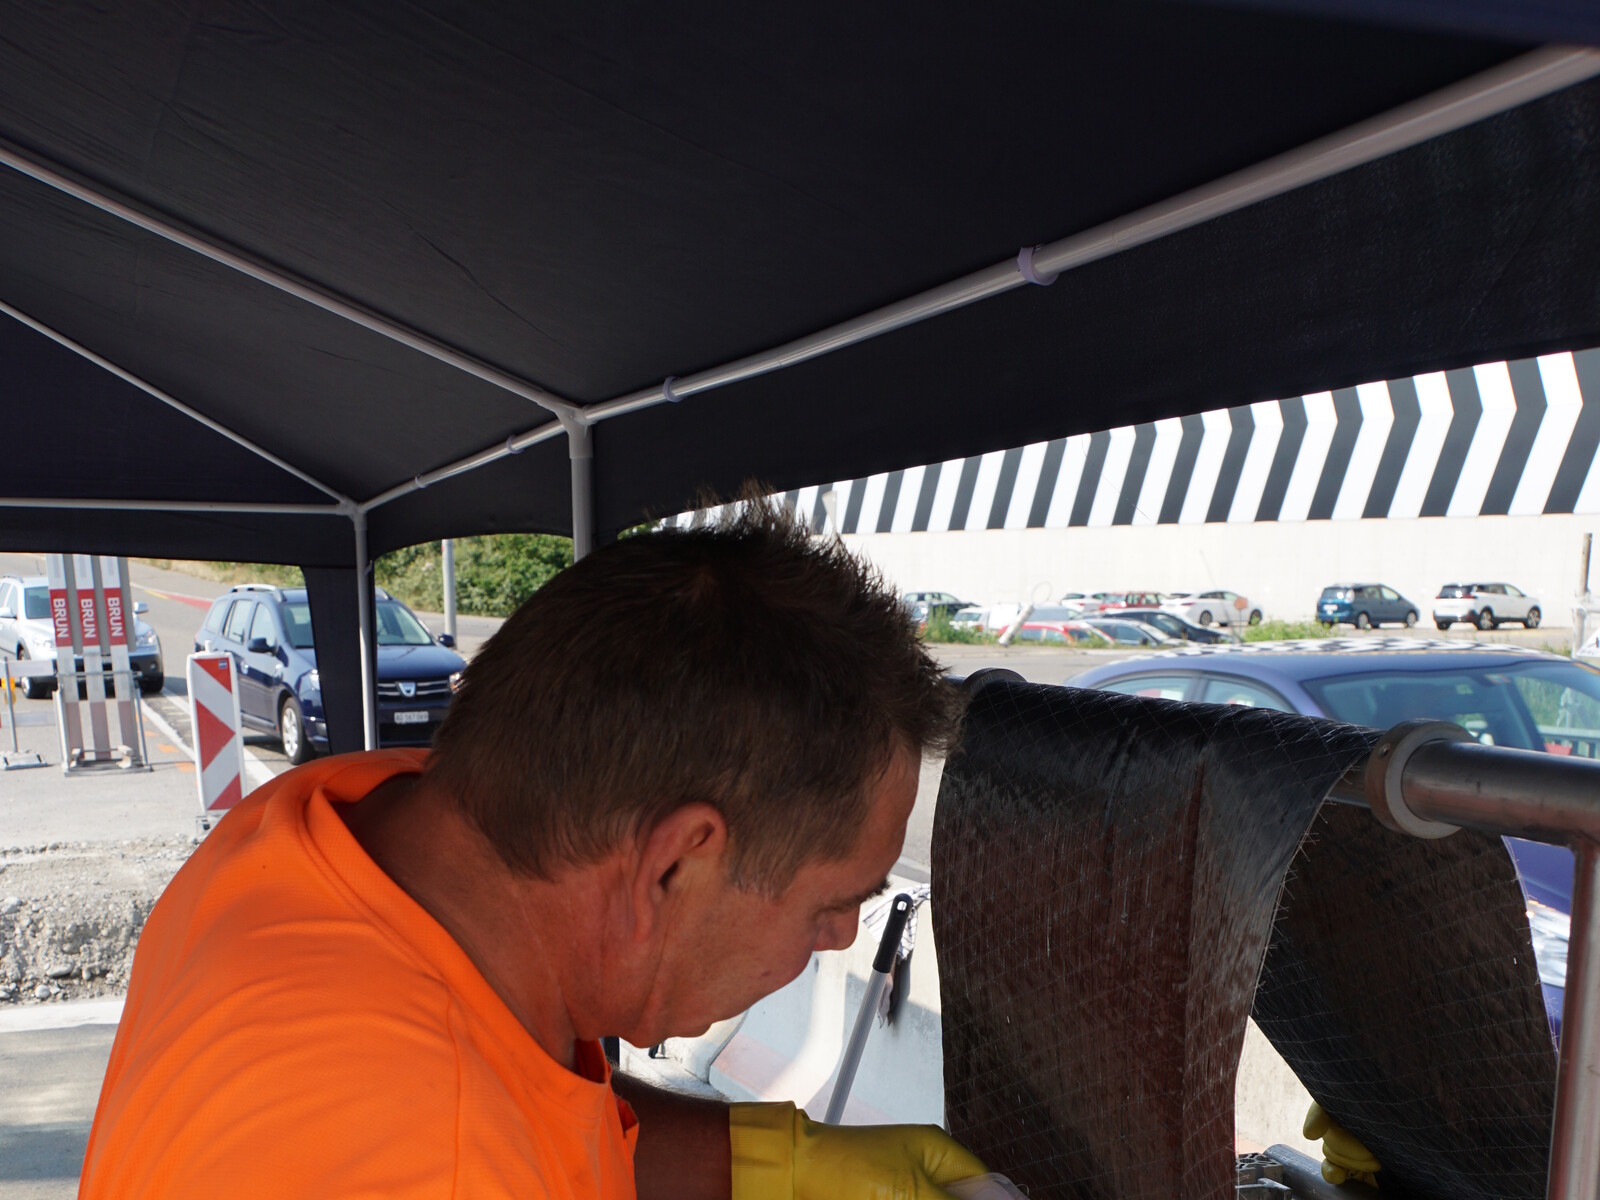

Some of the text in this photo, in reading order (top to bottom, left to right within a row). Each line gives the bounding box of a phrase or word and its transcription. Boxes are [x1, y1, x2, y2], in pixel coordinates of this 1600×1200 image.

[53, 598, 69, 638] BRUN
[80, 598, 96, 638] BRUN
[107, 598, 123, 637] BRUN
